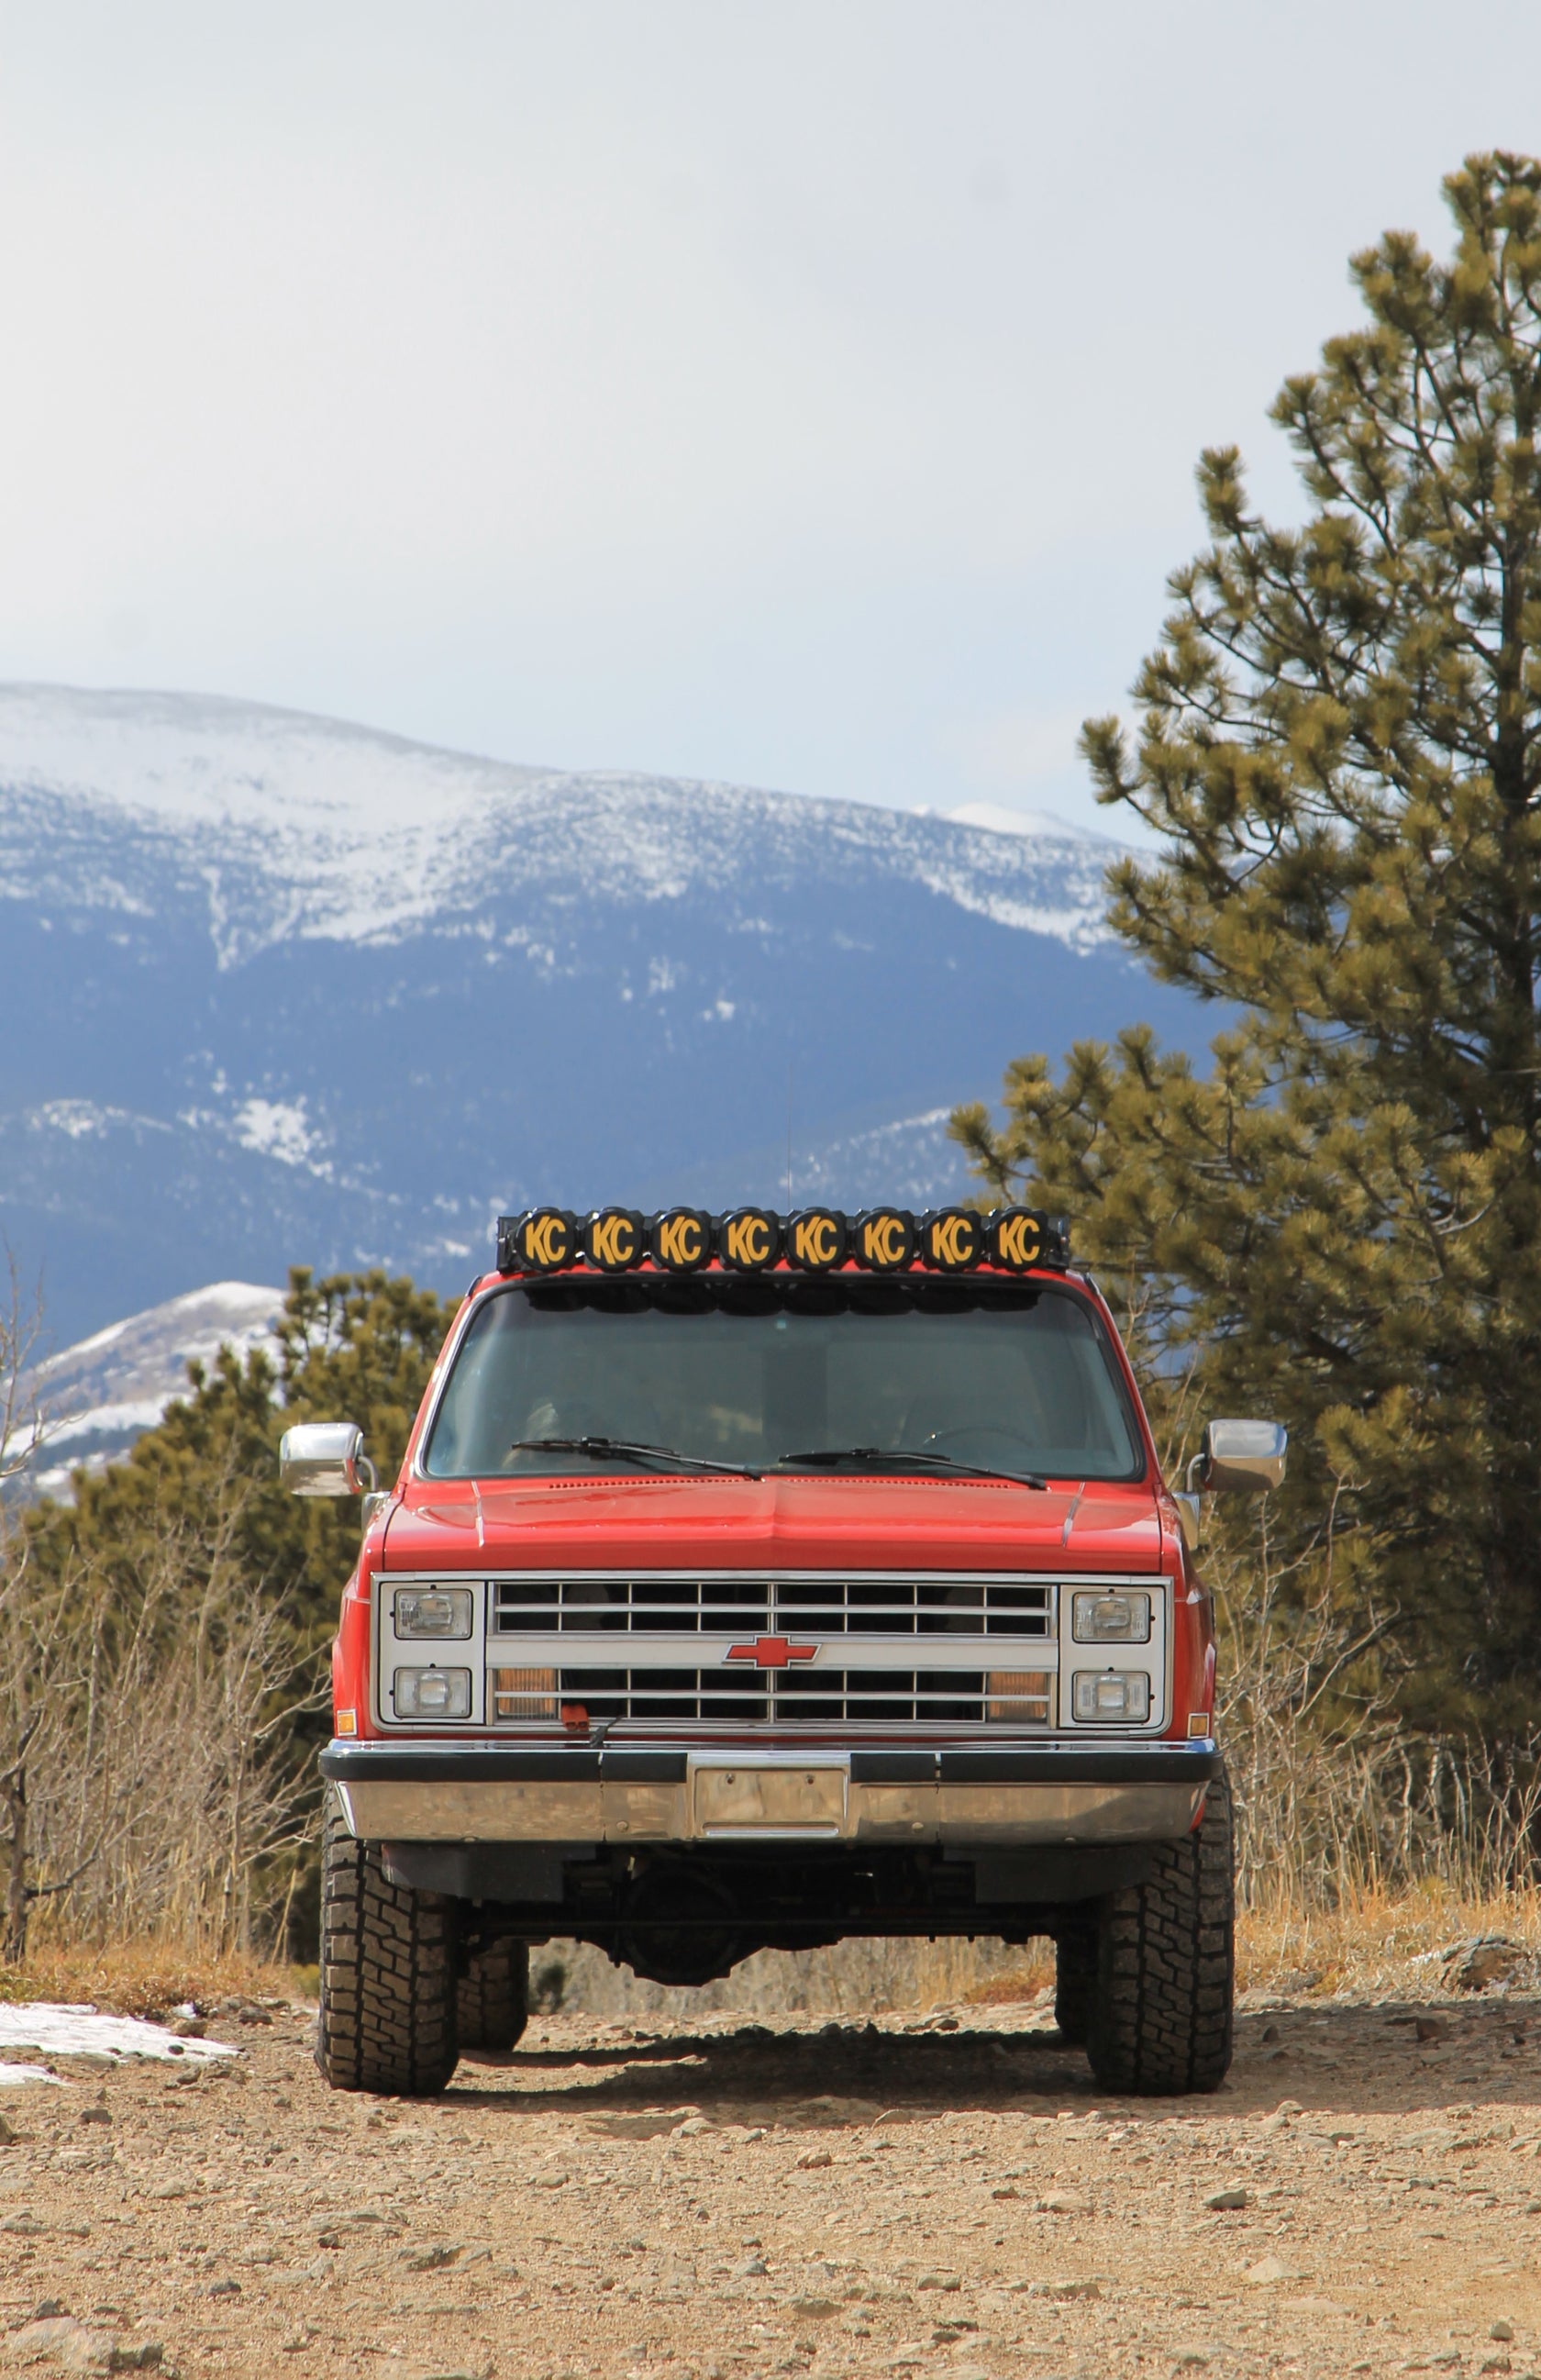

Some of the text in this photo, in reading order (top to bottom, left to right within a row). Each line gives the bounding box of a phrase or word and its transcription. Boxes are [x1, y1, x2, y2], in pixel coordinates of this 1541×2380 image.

[526, 1216, 565, 1264] KC
[593, 1216, 633, 1264] KC
[660, 1216, 701, 1264] KC
[728, 1216, 769, 1264] KC
[796, 1216, 837, 1264] KC
[864, 1216, 904, 1264] KC
[932, 1216, 972, 1264] KC
[1000, 1216, 1039, 1264] KC
